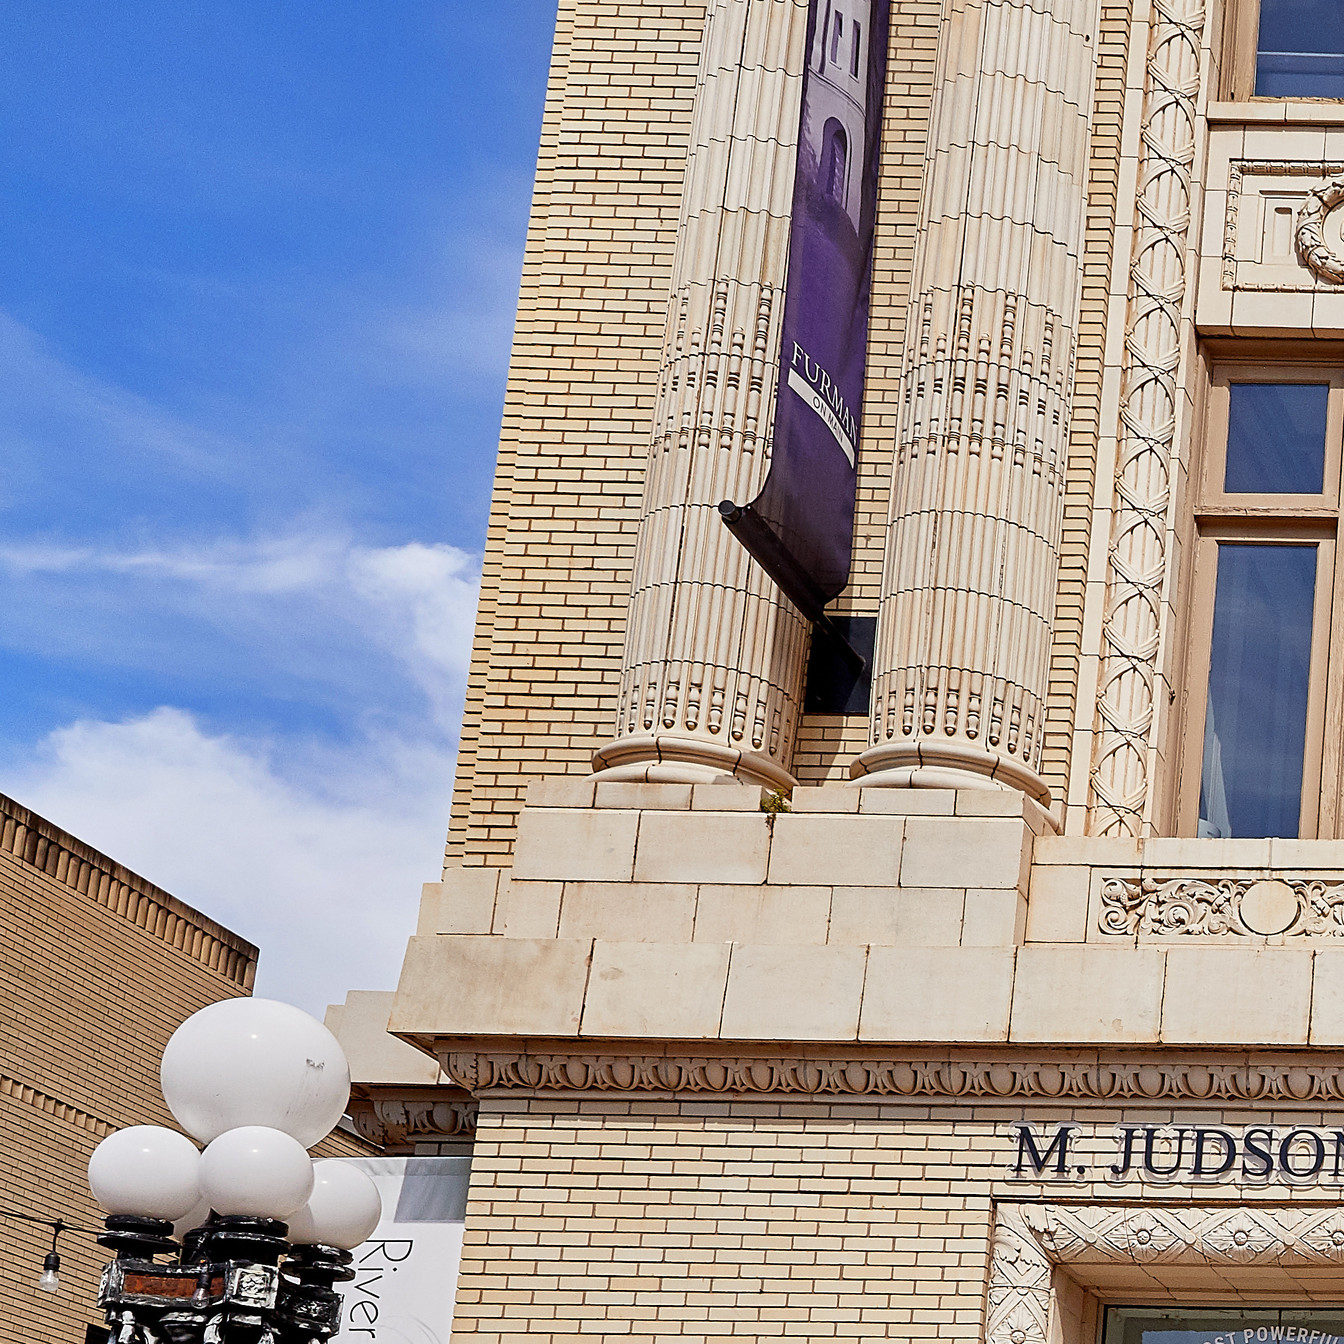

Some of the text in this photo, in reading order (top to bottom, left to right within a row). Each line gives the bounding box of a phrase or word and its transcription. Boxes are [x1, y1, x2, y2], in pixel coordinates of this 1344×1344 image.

[791, 340, 858, 447] FURMAN
[812, 396, 844, 443] ON MAIN
[1012, 1125, 1086, 1176] M.
[349, 1239, 413, 1339] River
